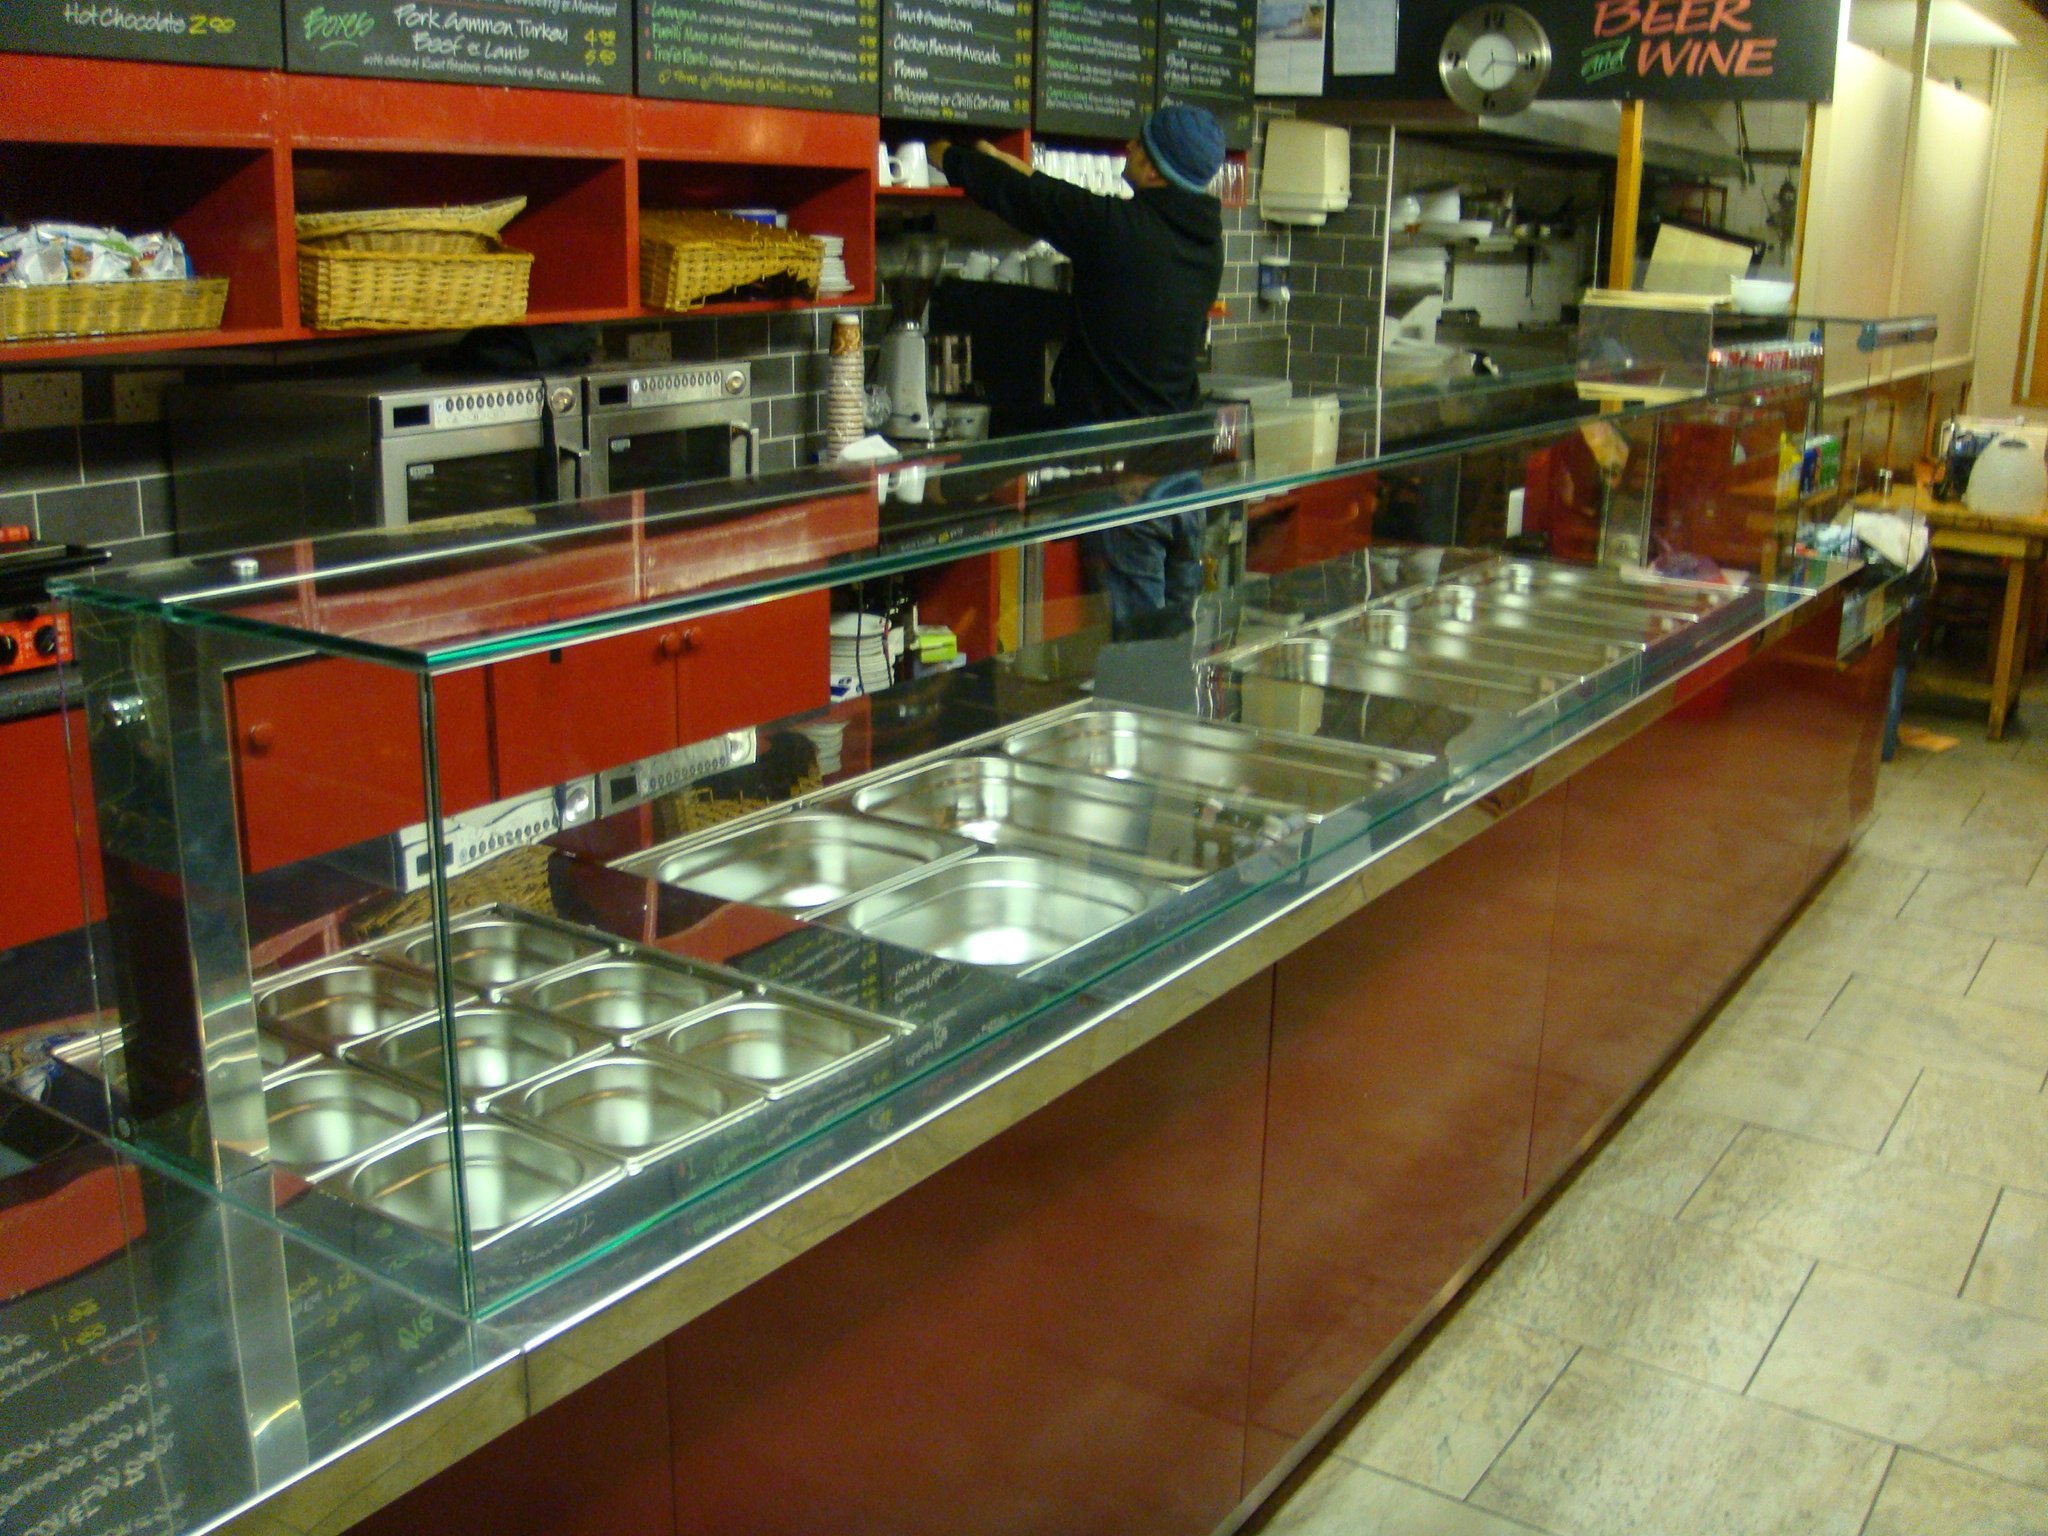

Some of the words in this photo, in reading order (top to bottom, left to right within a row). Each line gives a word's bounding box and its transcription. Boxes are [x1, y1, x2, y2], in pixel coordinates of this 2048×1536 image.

[516, 18, 569, 45] Turkey
[1593, 0, 1753, 37] BEER
[411, 31, 465, 55] Beef
[484, 42, 530, 61] Lamb
[1637, 38, 1777, 78] WINE
